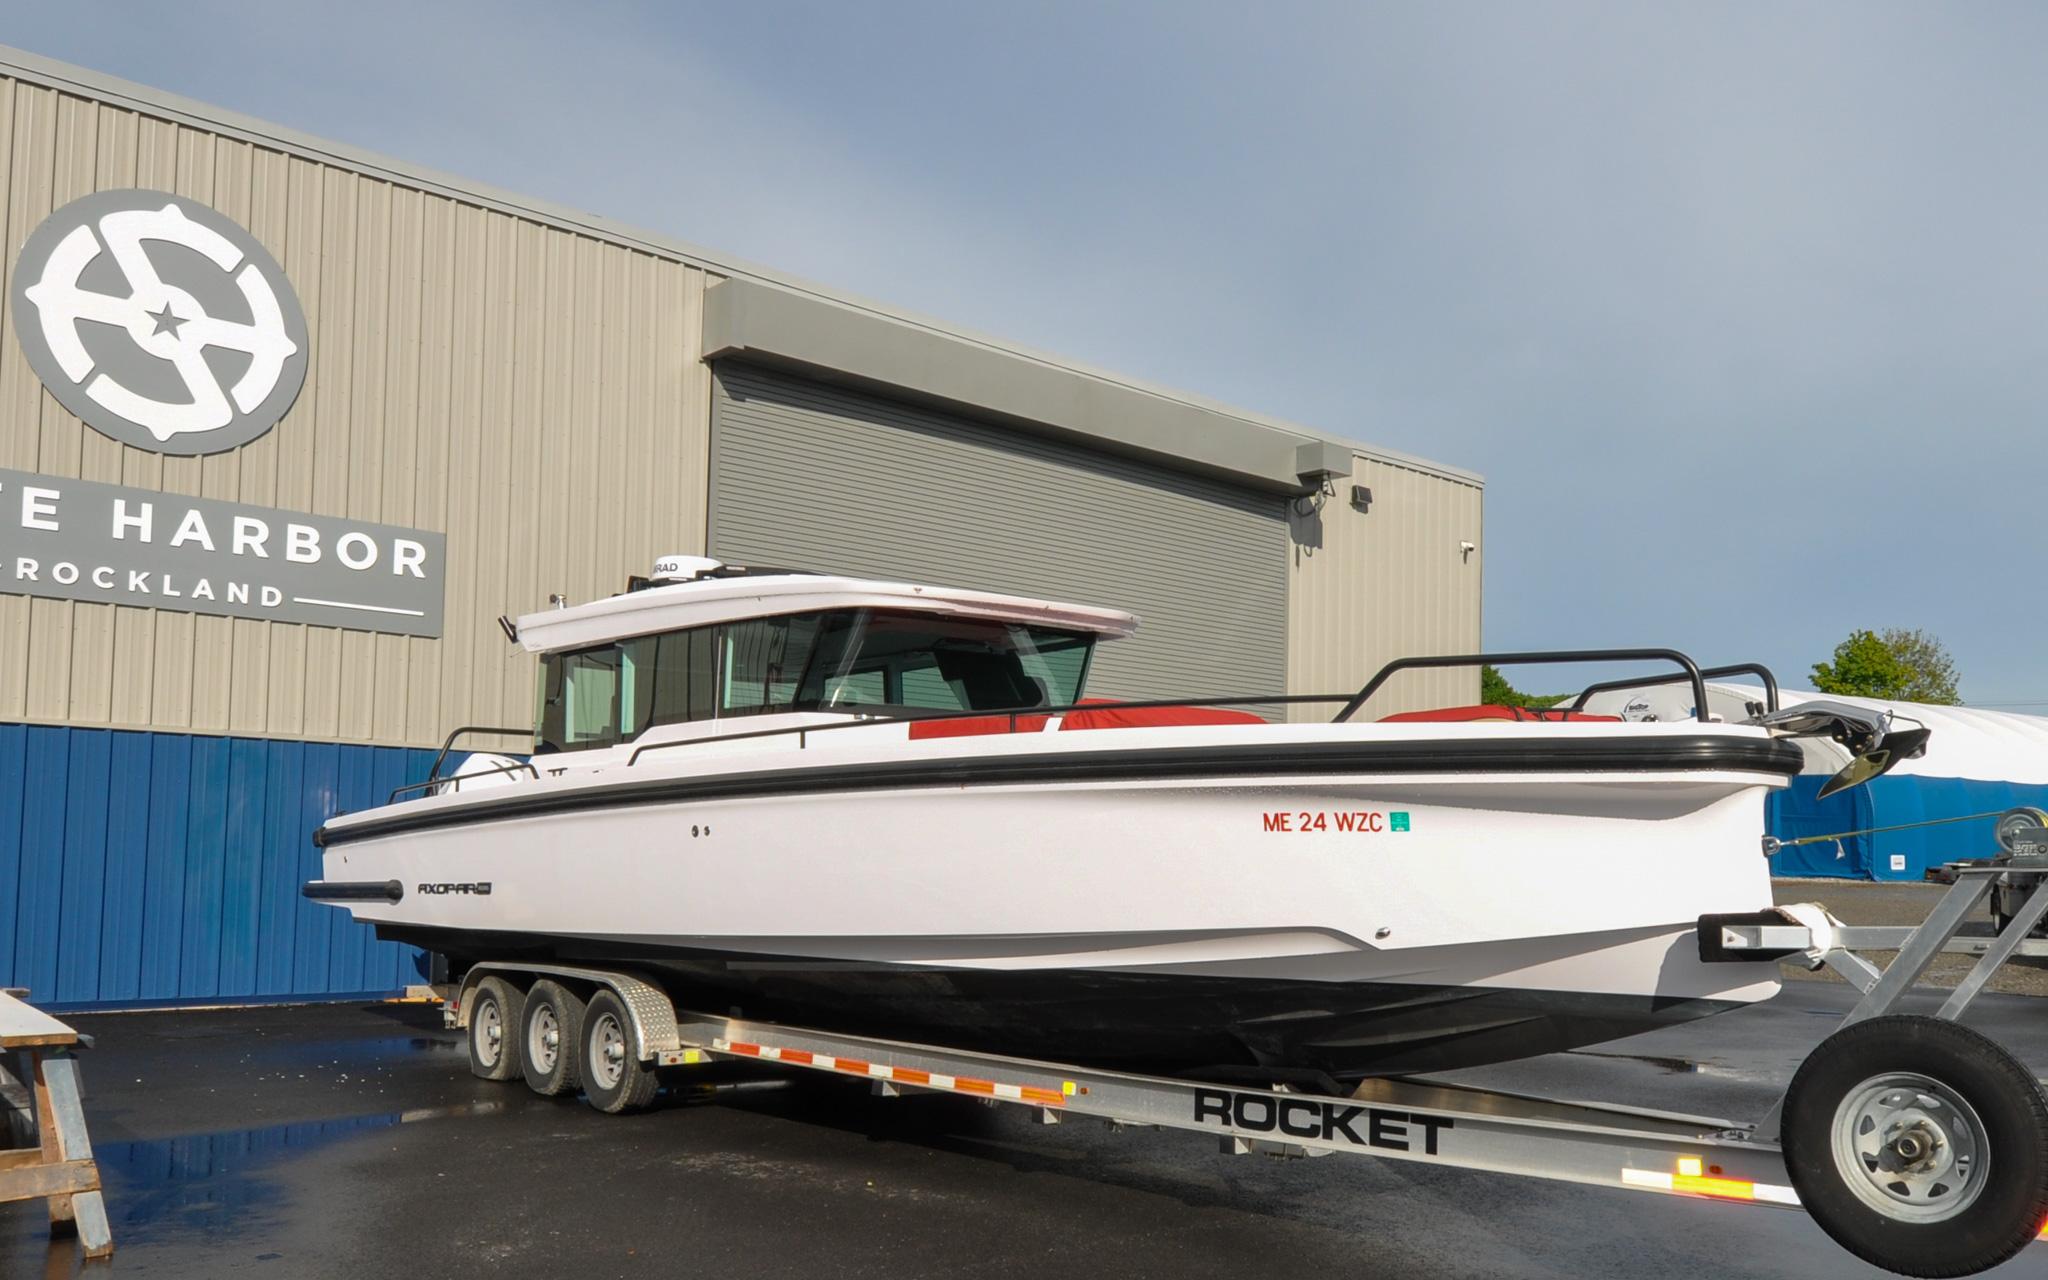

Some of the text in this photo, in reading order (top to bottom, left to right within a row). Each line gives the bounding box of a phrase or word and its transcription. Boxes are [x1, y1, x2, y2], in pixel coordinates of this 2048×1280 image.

[0, 482, 427, 578] E HARBOR
[16, 557, 282, 607] ROCKLAND
[653, 562, 679, 574] RAD
[1263, 812, 1292, 832] ME
[1299, 812, 1327, 832] 24
[1334, 812, 1383, 832] WZC
[417, 883, 477, 895] AXOPAR
[1194, 1087, 1454, 1156] ROCKET
